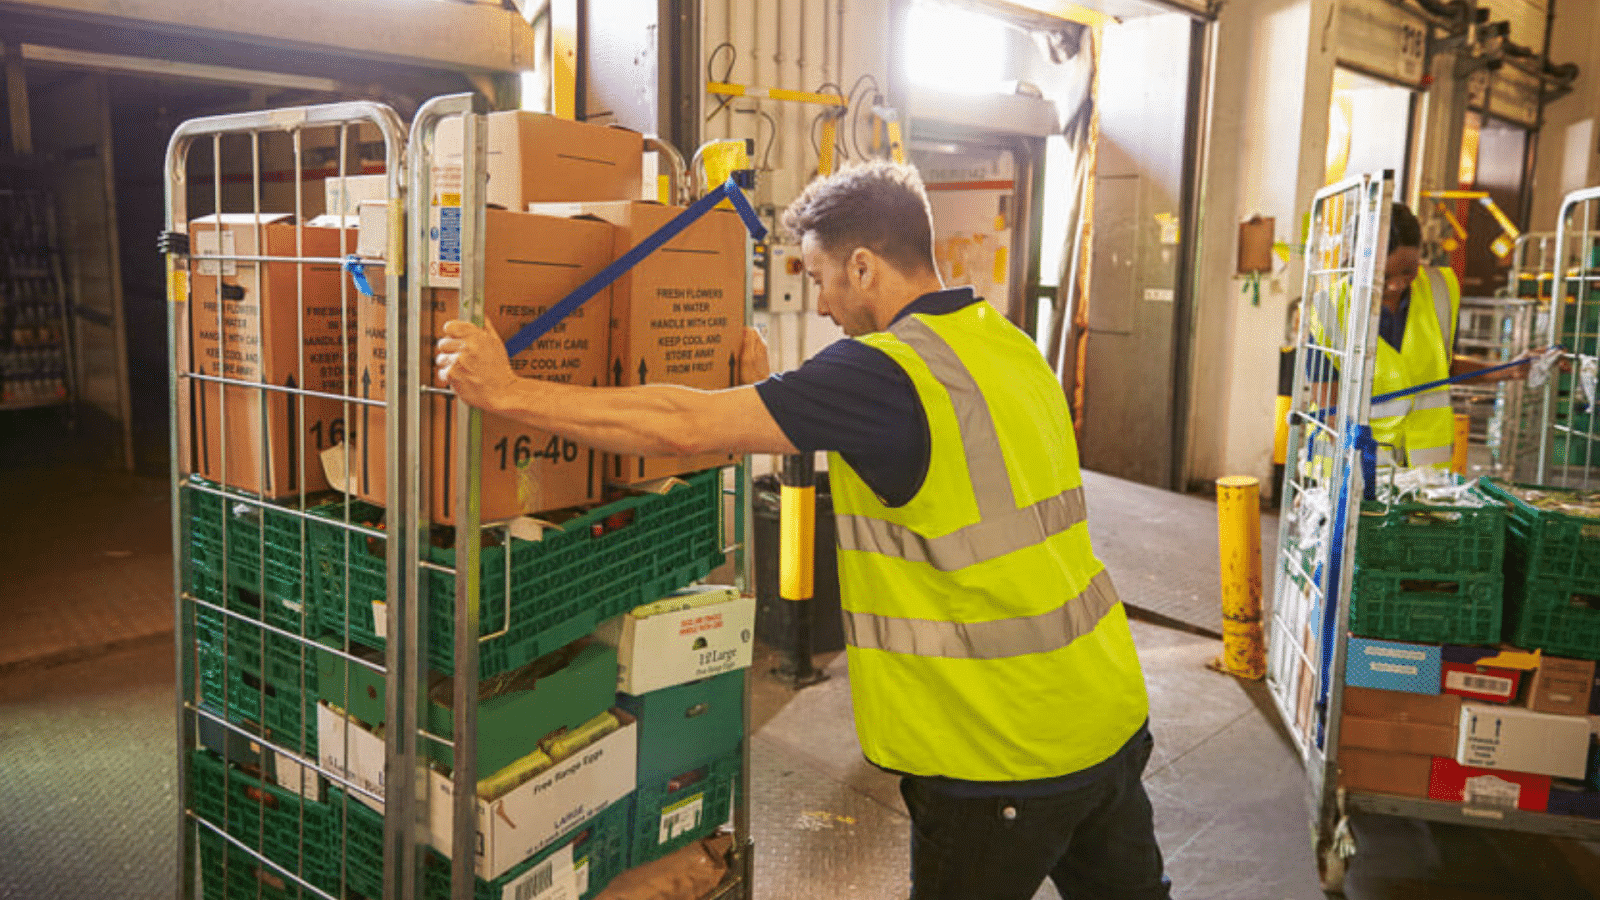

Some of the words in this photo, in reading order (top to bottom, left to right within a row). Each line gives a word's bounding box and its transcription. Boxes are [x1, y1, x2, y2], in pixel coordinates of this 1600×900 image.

[657, 288, 685, 299] FRESH
[686, 288, 723, 299] FLOWERS
[500, 305, 536, 316] FRESH
[673, 303, 681, 312] IN
[683, 302, 710, 313] WATER
[650, 319, 685, 329] HANDLE
[686, 318, 706, 328] WITH
[707, 317, 728, 327] CARE
[537, 339, 561, 350] WITH
[563, 339, 589, 350] CARE
[658, 336, 681, 347] KEEP
[682, 335, 703, 346] COOL
[706, 334, 722, 344] AND
[666, 350, 692, 361] STORE
[694, 348, 715, 358] AWAY
[530, 359, 558, 370] COOL
[560, 357, 580, 369] AND
[667, 364, 691, 375] FROM
[692, 362, 714, 373] FRUIT
[534, 778, 553, 796] Free
[555, 761, 582, 782] Range
[583, 748, 603, 766] Eggs
